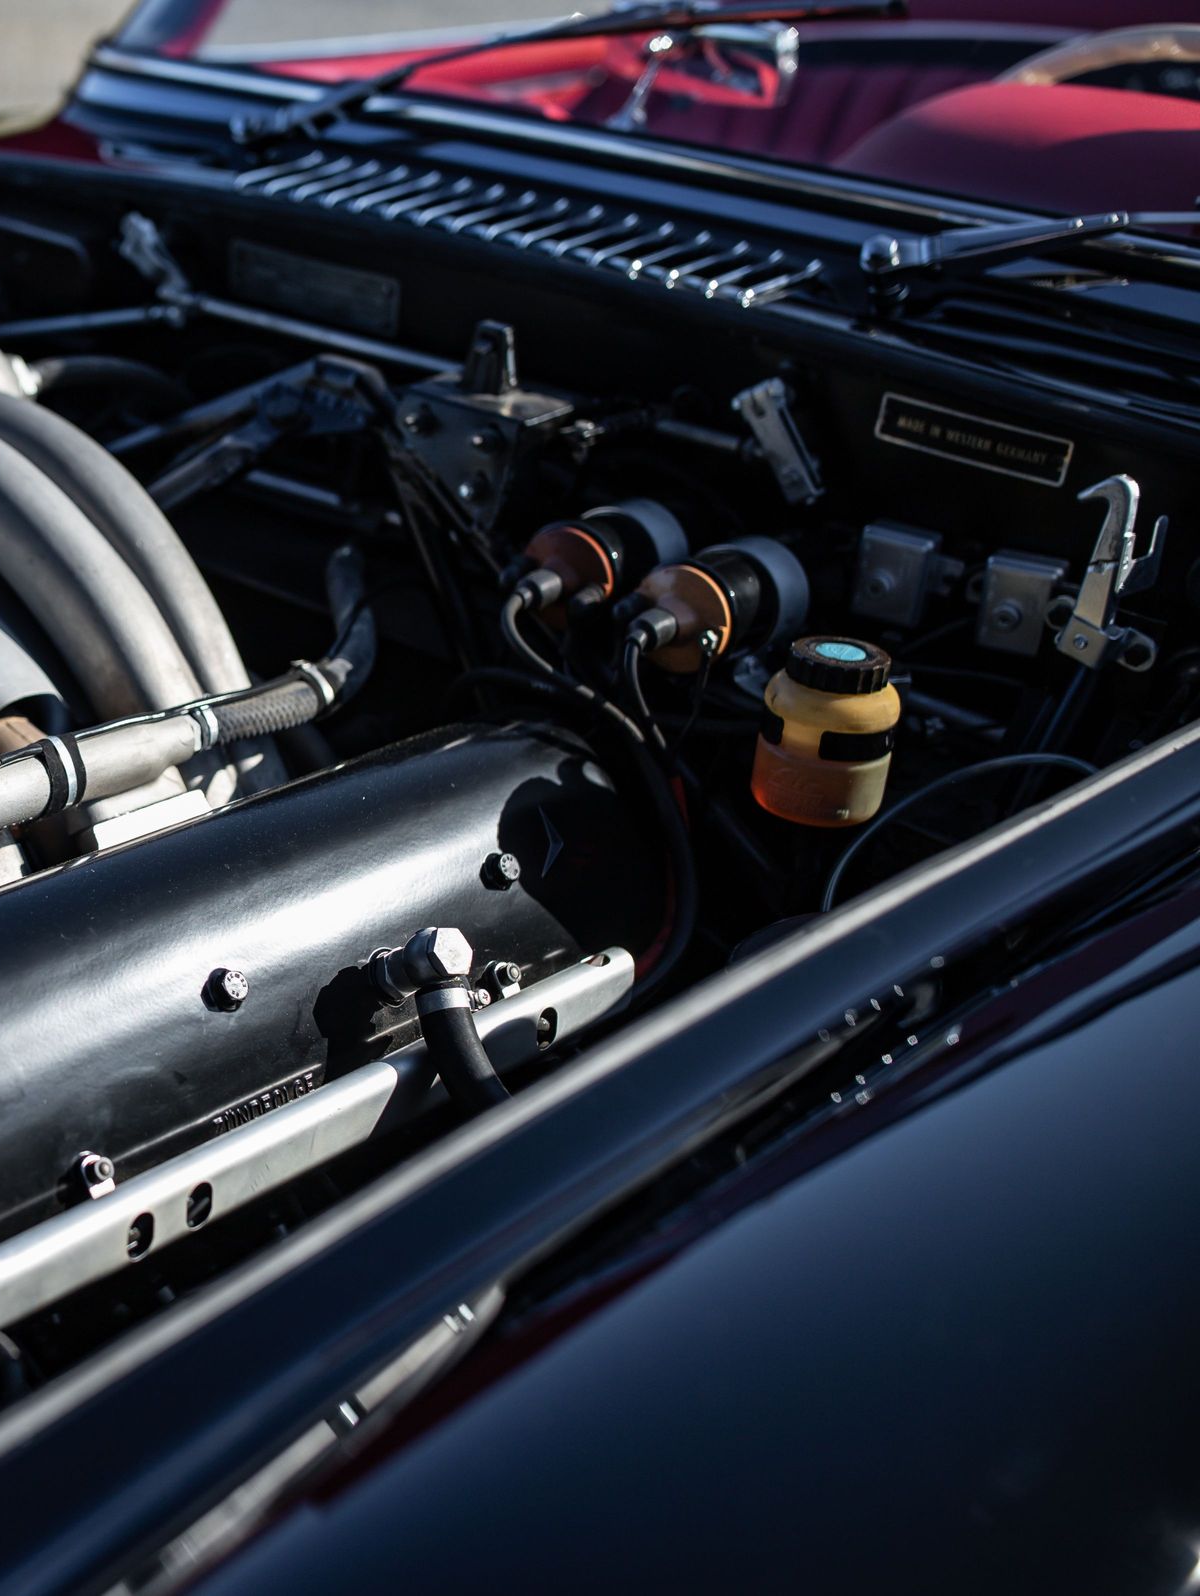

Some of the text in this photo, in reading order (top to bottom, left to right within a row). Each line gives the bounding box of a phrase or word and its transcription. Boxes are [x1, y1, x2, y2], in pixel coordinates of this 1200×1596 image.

[897, 415, 1048, 466] MADE IN WESTERN GERMANY
